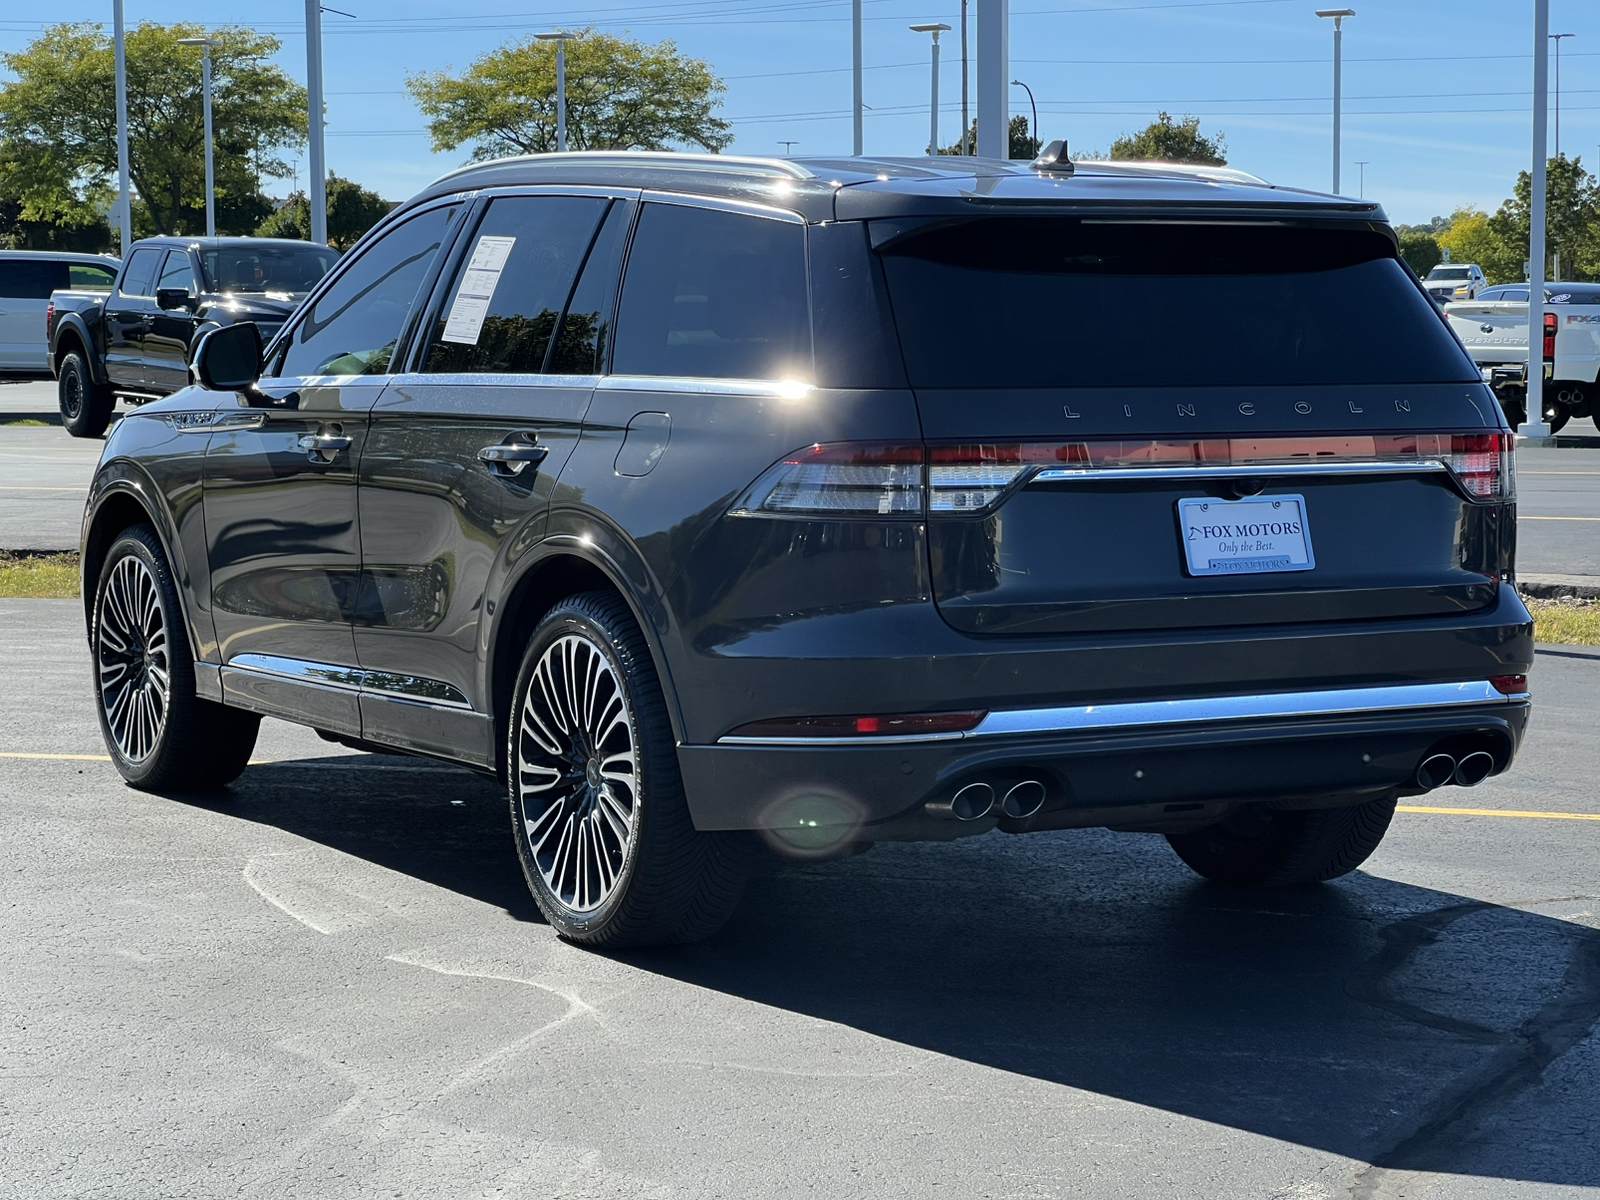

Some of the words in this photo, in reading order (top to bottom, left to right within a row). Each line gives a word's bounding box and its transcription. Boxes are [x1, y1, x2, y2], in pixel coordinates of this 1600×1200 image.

[1566, 315, 1600, 324] FX4
[1493, 337, 1528, 345] DUTY
[1063, 399, 1412, 419] LINCOLN
[1203, 525, 1233, 539] FOX
[1235, 521, 1300, 537] MOTORS
[1218, 541, 1239, 555] Only
[1240, 541, 1253, 552] the
[1255, 540, 1275, 551] Best.
[1225, 561, 1243, 571] FOX
[1244, 559, 1285, 570] MOTORS
